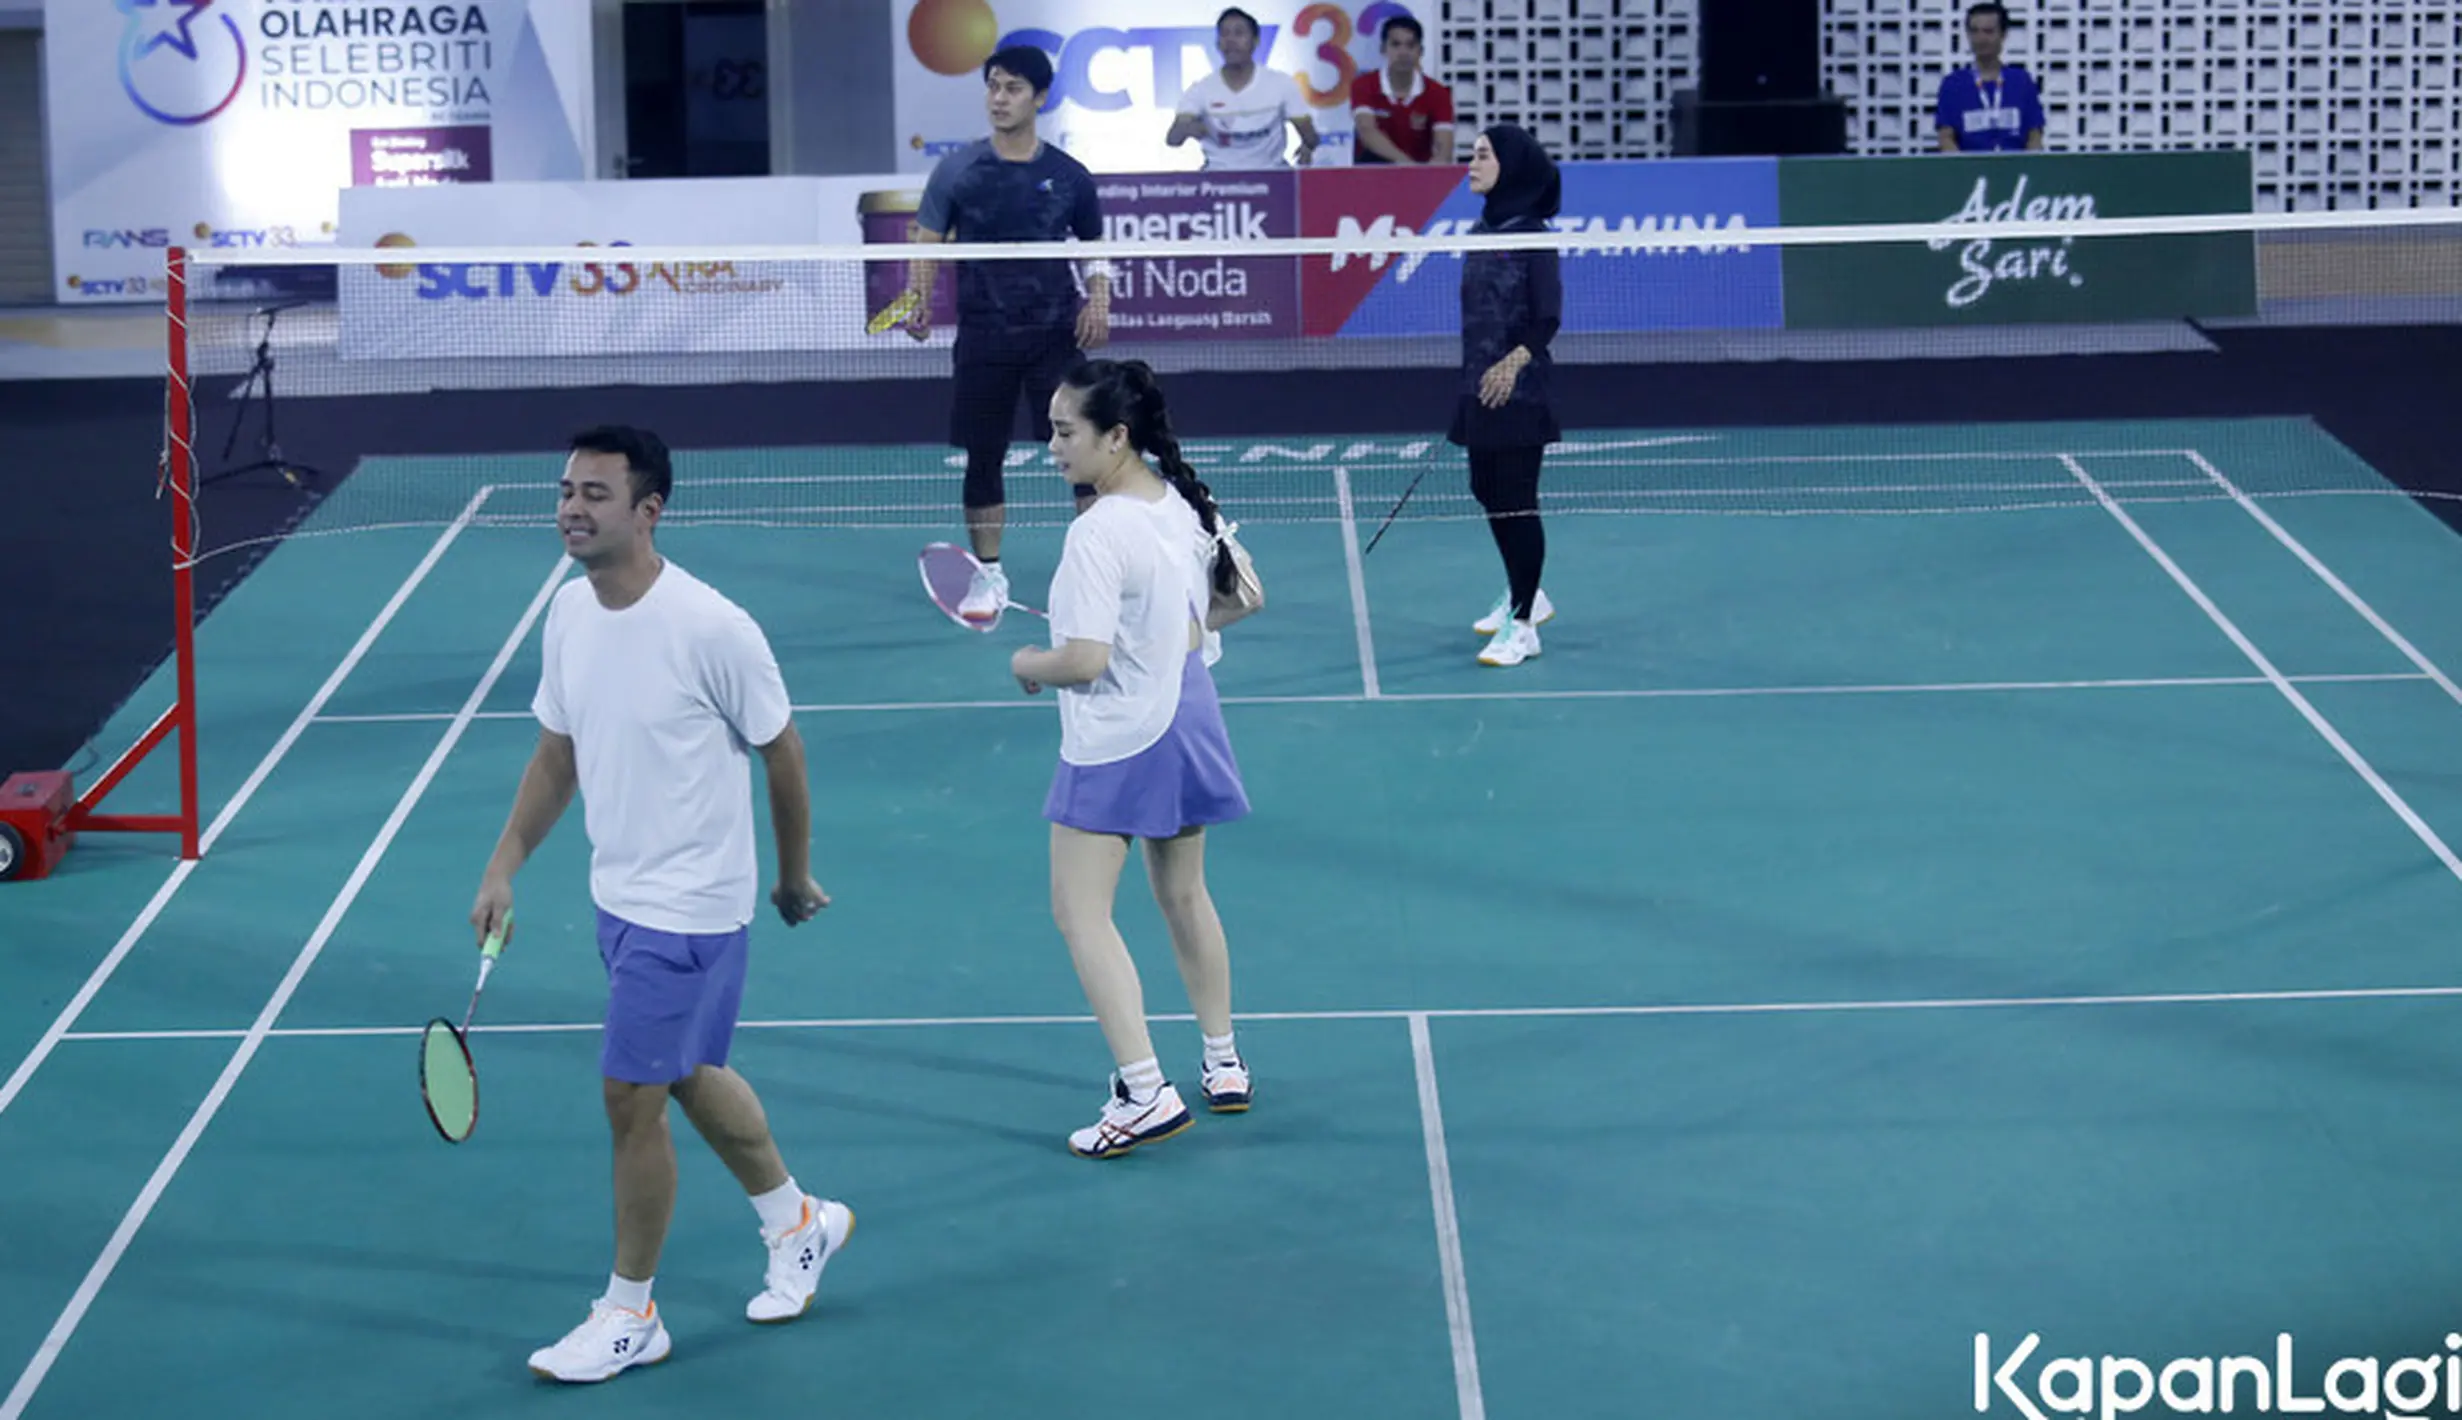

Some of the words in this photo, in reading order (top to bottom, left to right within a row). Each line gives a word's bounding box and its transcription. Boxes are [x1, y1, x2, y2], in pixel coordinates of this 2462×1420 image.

[260, 5, 489, 38] OLAHRAGA
[261, 41, 492, 76] SELEBRITI
[261, 76, 491, 109] INDONESIA
[1097, 183, 1138, 201] nding
[1141, 182, 1197, 198] Interior
[1201, 181, 1270, 197] Premium
[1102, 202, 1269, 241] persilk
[1928, 173, 2097, 250] Adem
[82, 229, 169, 248] RANS
[211, 230, 267, 248] SCTV
[417, 260, 563, 299] SCTV
[570, 241, 640, 296] 33
[1144, 258, 1248, 299] Noda
[80, 280, 126, 296] SCTV
